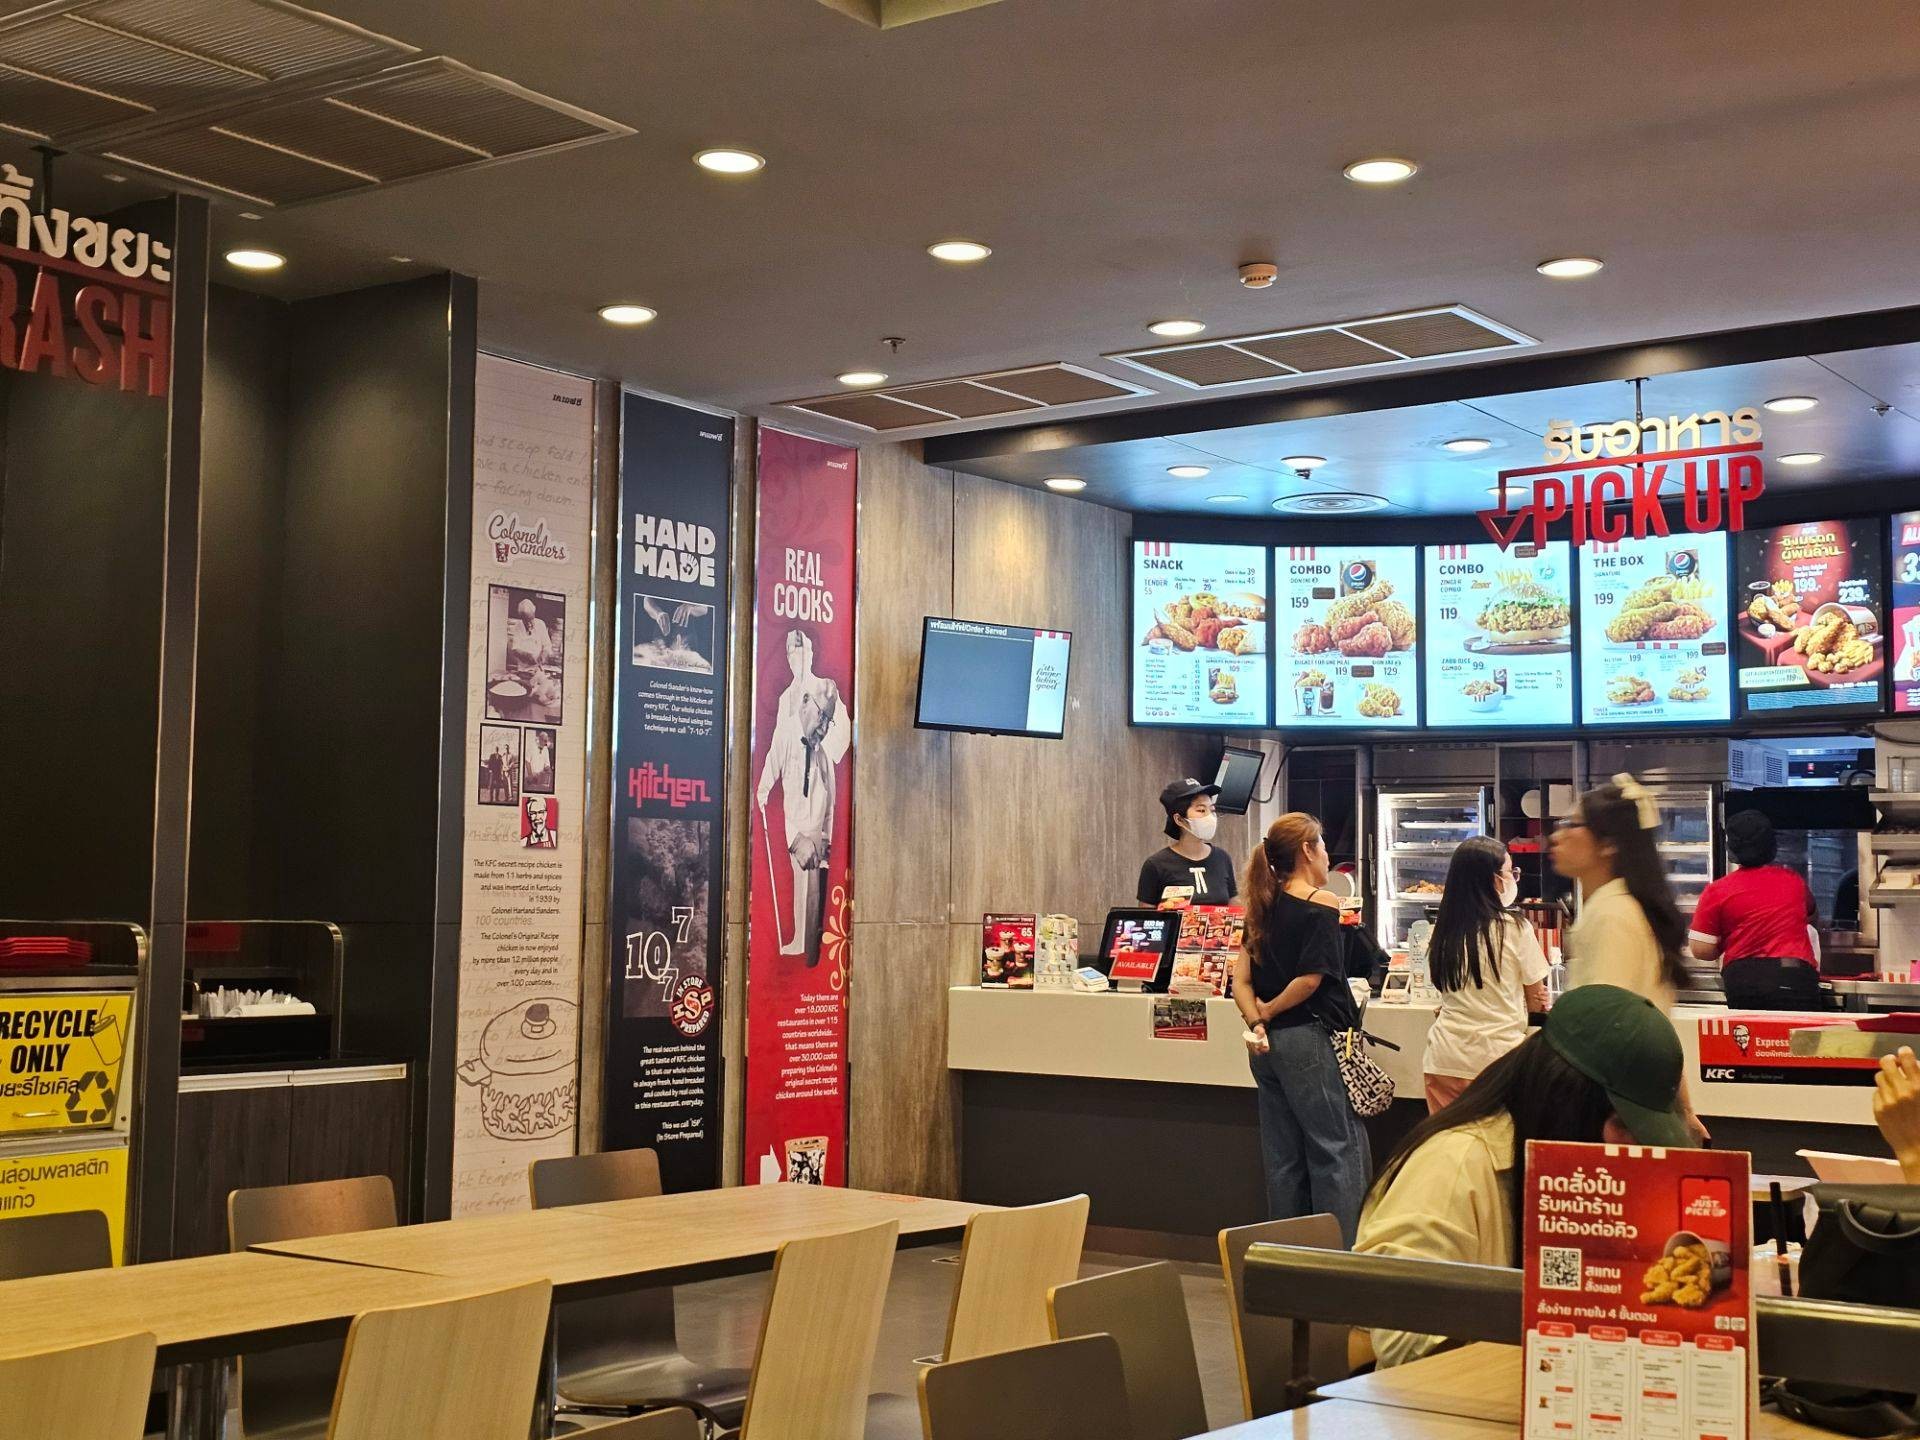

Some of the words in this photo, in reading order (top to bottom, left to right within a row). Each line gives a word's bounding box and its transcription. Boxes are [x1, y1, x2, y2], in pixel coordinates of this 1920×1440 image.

[1542, 407, 1763, 465] รับอาหาร
[1532, 464, 1670, 550] PICK
[1684, 455, 1764, 534] UP
[488, 515, 542, 544] Colonel
[634, 513, 716, 556] HAND
[510, 535, 566, 560] Sanders
[634, 543, 715, 587] MADE
[785, 547, 824, 587] REAL
[1144, 559, 1183, 570] SNACK
[1594, 558, 1616, 568] THE
[1620, 555, 1644, 566] BOX
[1290, 565, 1331, 574] COMBO
[1440, 564, 1484, 575] COMBO
[773, 583, 834, 624] COOKS
[1291, 597, 1309, 608] 159
[1594, 593, 1614, 605] 199
[1440, 607, 1457, 619] 119
[985, 627, 1007, 636] Served
[1629, 654, 1641, 662] 199
[1687, 650, 1698, 659] 199
[1335, 666, 1347, 675] 119
[1384, 667, 1397, 675] 129
[1473, 661, 1484, 670] 99
[536, 884, 562, 892] Kentucky
[491, 906, 512, 914] Colonel
[671, 906, 694, 943] 7
[518, 932, 539, 941] Original
[540, 932, 559, 941] Recipe
[537, 944, 558, 953] enjoyed
[472, 957, 479, 965] by
[540, 956, 558, 964] people
[625, 931, 671, 980] 10
[1118, 961, 1155, 970] AVAILABLE
[657, 968, 679, 1002] 7
[676, 985, 684, 997] IN
[682, 976, 703, 989] STORE
[800, 993, 815, 1003] Today
[828, 1004, 838, 1012] KFC
[680, 1010, 710, 1033] PREPARED
[1756, 1037, 1789, 1048] Express
[10, 1043, 71, 1075] ONLY
[1705, 1068, 1735, 1079] KFC
[0, 1186, 35, 1211] แก้ว
[1691, 1199, 1720, 1207] JUST
[1539, 1194, 1622, 1216] รับหน้าร้าน
[1685, 1206, 1710, 1216] PICK
[1538, 1214, 1638, 1239] ไม่ต้องต่อคิว
[1585, 1266, 1620, 1279] สแกน
[1585, 1280, 1622, 1294] สั่งเลย!
[1537, 1299, 1571, 1316] สั่งง่าย
[1574, 1305, 1606, 1319] ภายใน
[1608, 1309, 1616, 1319] 4
[1619, 1307, 1657, 1323] ขั้นตอน
